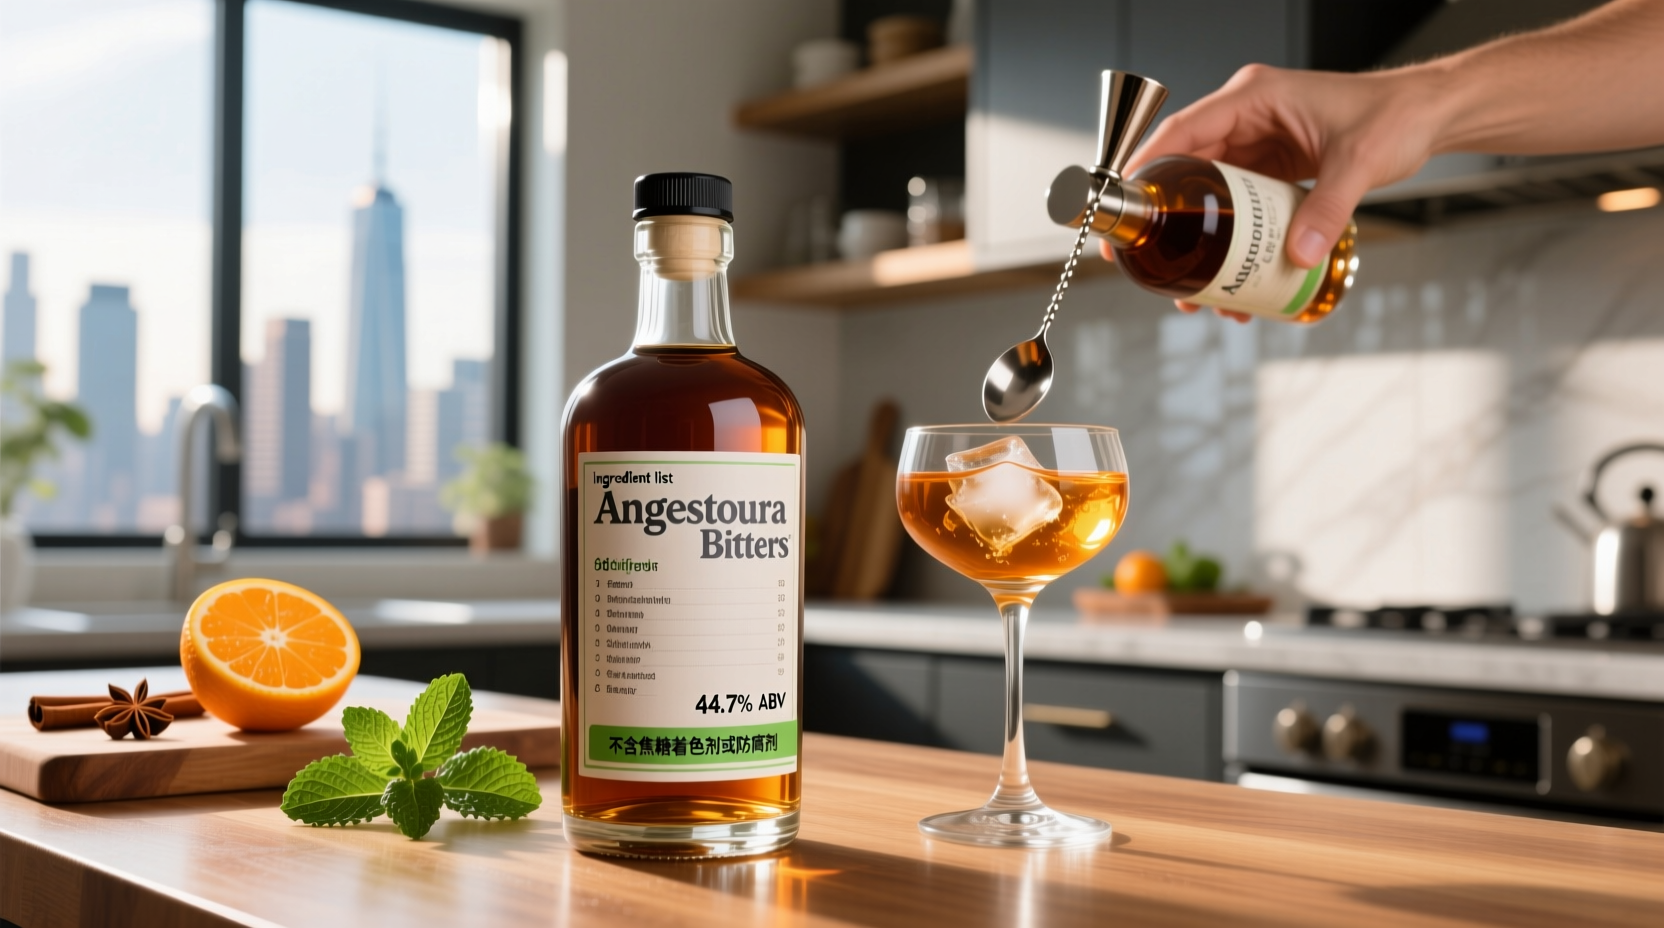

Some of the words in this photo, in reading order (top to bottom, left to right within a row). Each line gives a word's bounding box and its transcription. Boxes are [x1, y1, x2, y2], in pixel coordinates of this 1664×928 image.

[593, 471, 650, 488] Ingredient
[655, 471, 674, 484] list
[593, 490, 787, 536] Angestoura
[699, 528, 790, 559] Bitters
[695, 693, 753, 715] 44.7%
[758, 691, 787, 712] ABV
